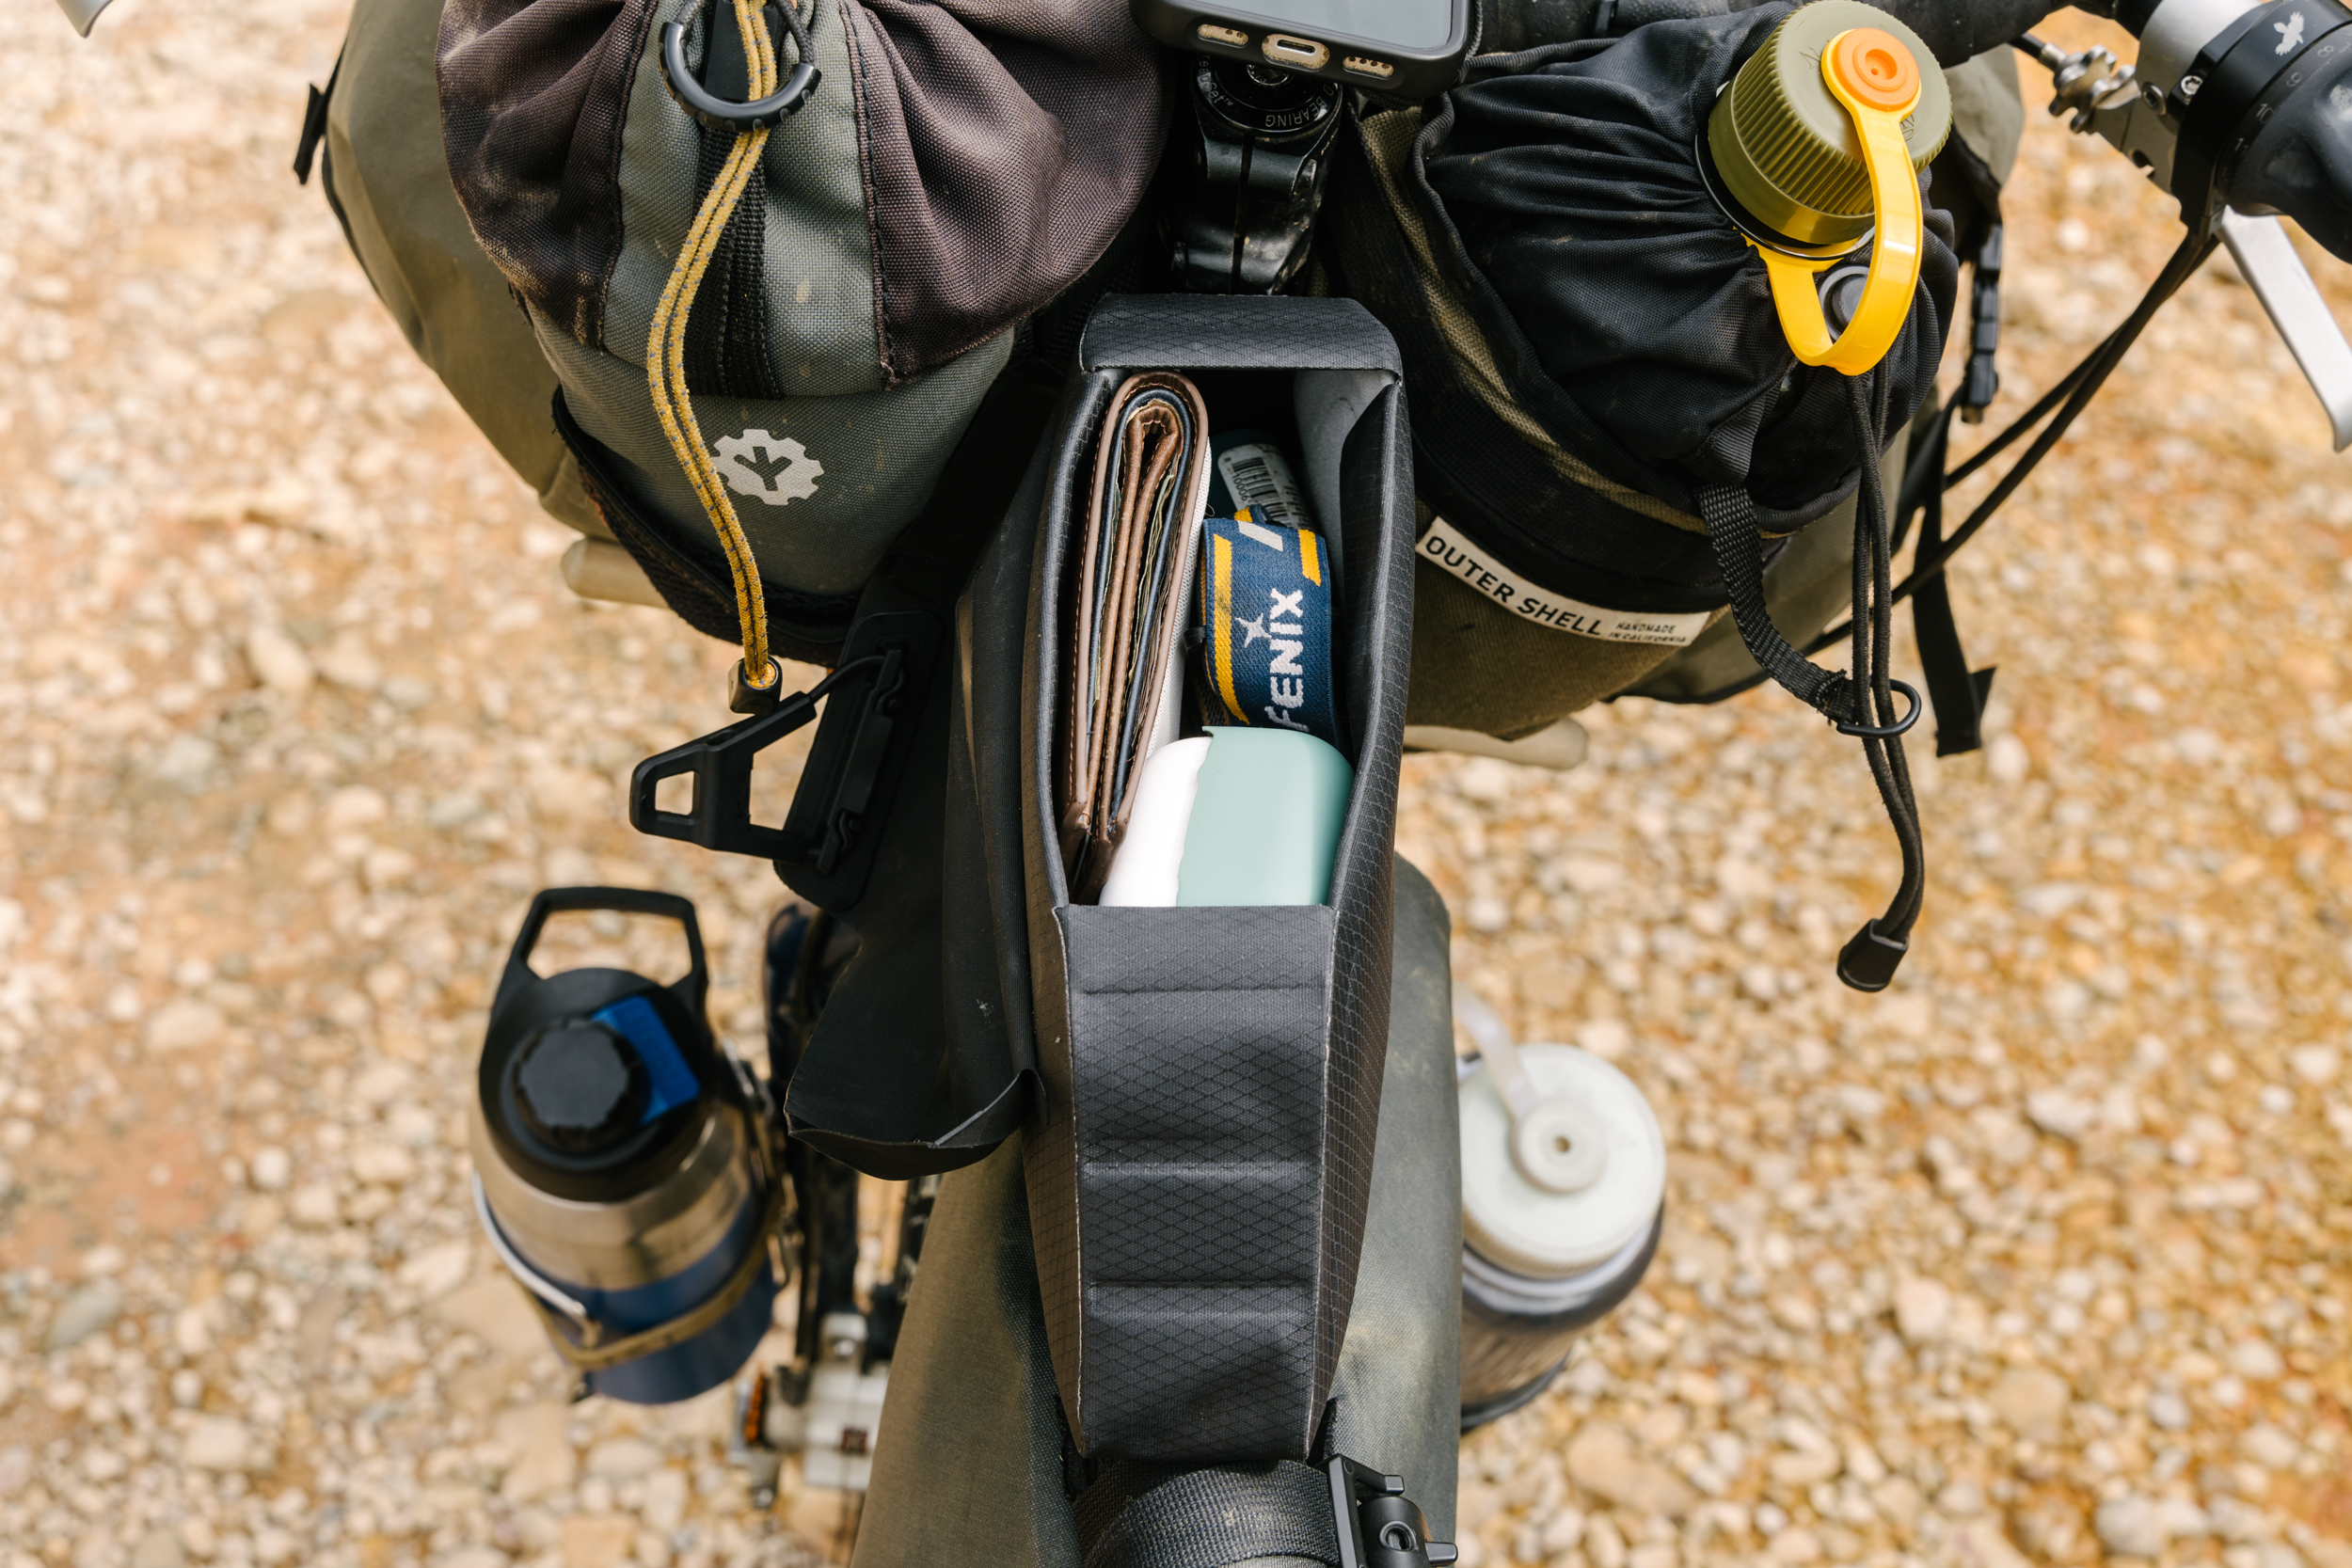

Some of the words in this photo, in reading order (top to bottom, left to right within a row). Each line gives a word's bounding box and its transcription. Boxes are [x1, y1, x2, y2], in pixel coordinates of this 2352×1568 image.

[2317, 45, 2334, 58] 8
[2286, 71, 2303, 87] 9
[1264, 96, 1327, 127] BEARING
[2255, 103, 2274, 124] 10
[2234, 137, 2249, 157] 11
[1232, 472, 1248, 501] 10006
[1425, 535, 1515, 603] OUTER
[1517, 597, 1601, 636] SHELL
[1615, 622, 1677, 634] HANDMADE
[1622, 632, 1687, 643] CALIFORNIA
[1264, 587, 1310, 733] FENIX
